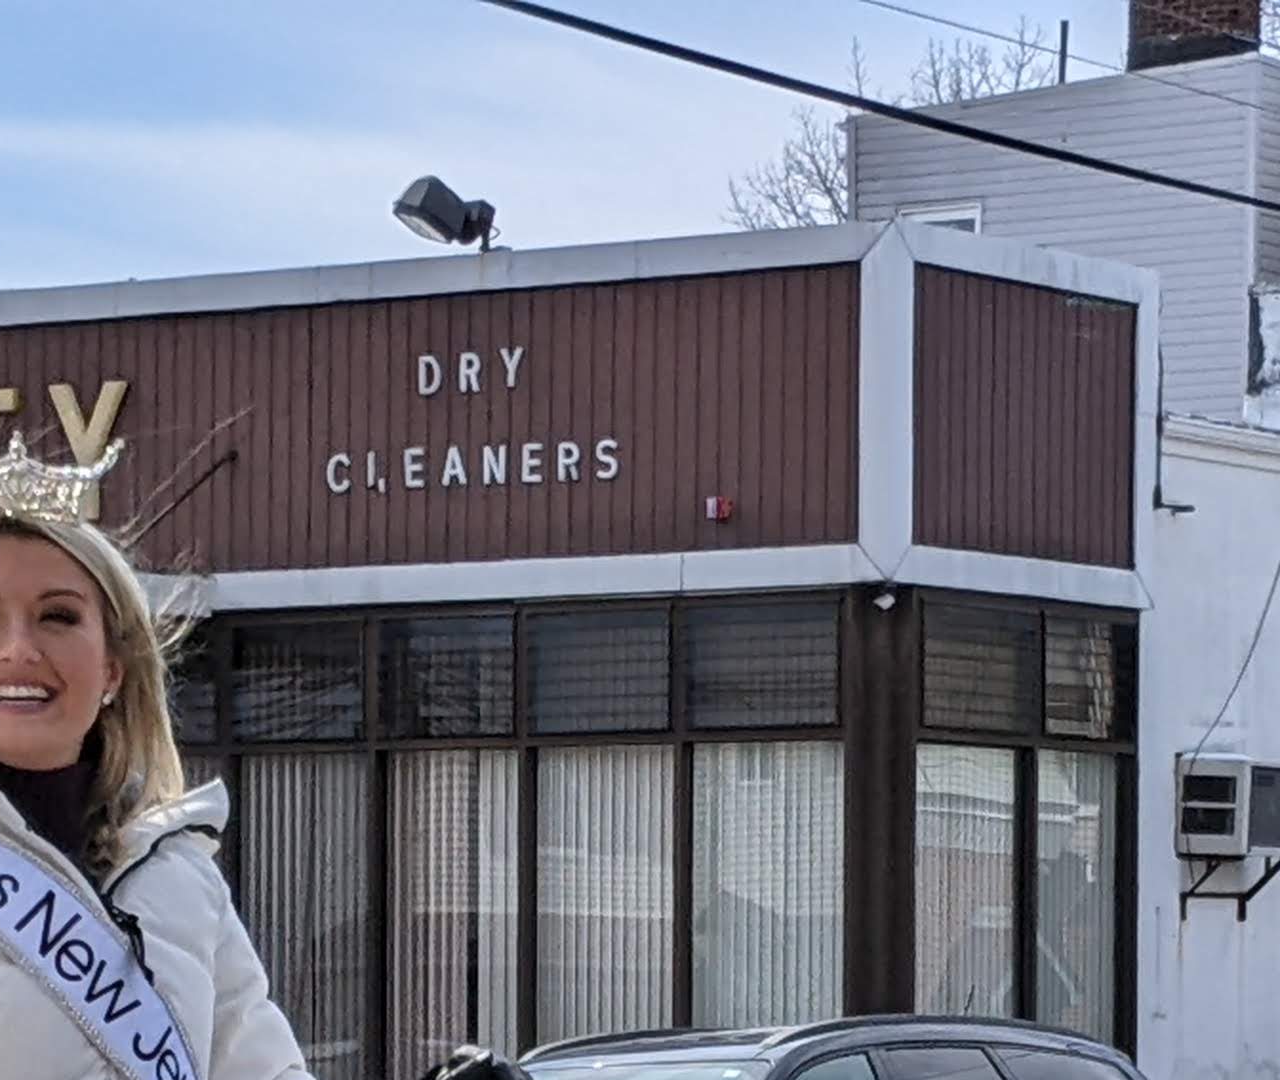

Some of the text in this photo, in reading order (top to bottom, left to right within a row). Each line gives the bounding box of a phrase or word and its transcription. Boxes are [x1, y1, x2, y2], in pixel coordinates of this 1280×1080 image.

[419, 346, 525, 396] DRY
[326, 439, 620, 494] CLEANERS
[14, 889, 141, 1024] New
